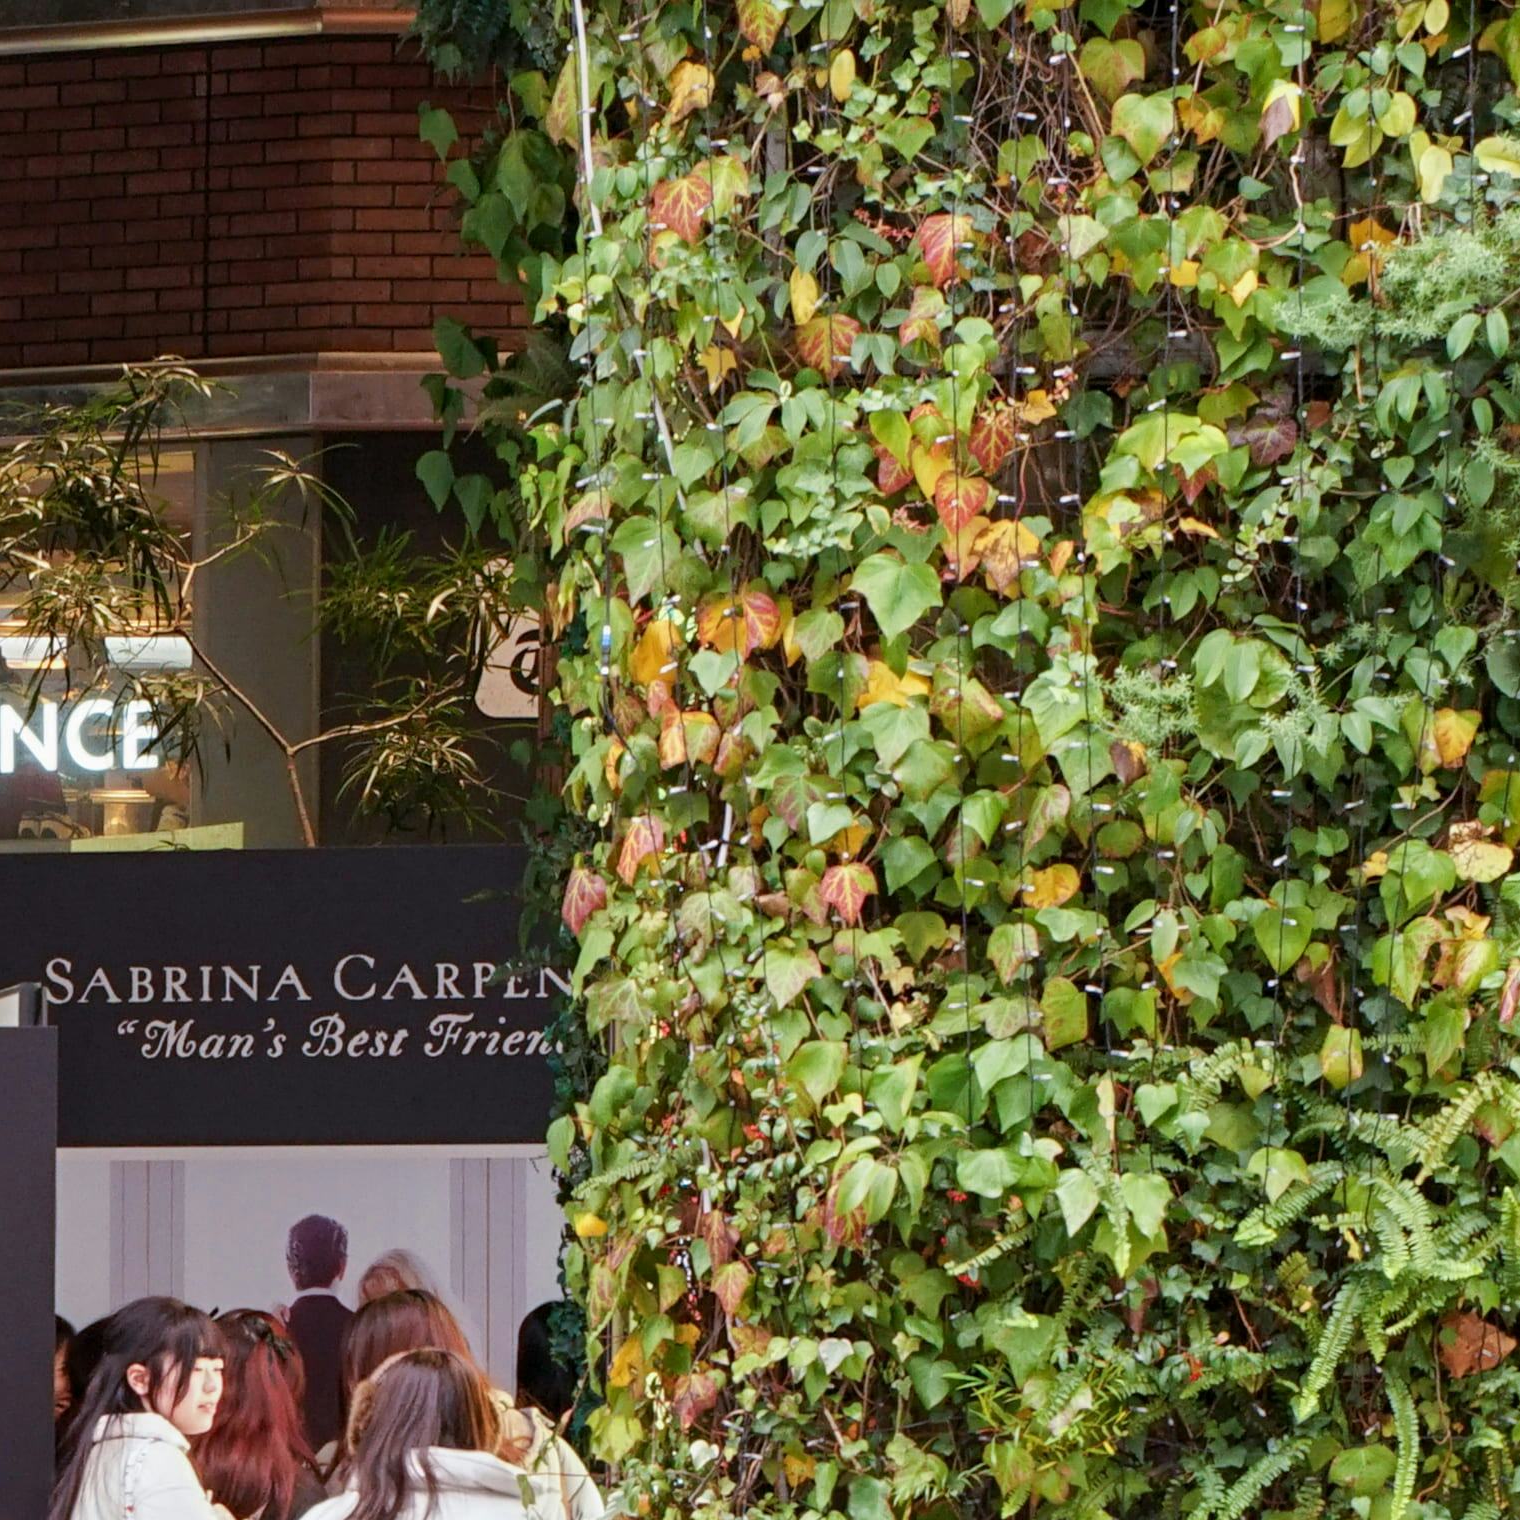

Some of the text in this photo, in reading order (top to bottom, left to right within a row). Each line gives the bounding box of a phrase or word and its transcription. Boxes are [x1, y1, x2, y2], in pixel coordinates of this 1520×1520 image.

[44, 954, 572, 1005] SABRINA CARPEN
[301, 1012, 409, 1058] Best
[423, 1012, 565, 1060] Frien
